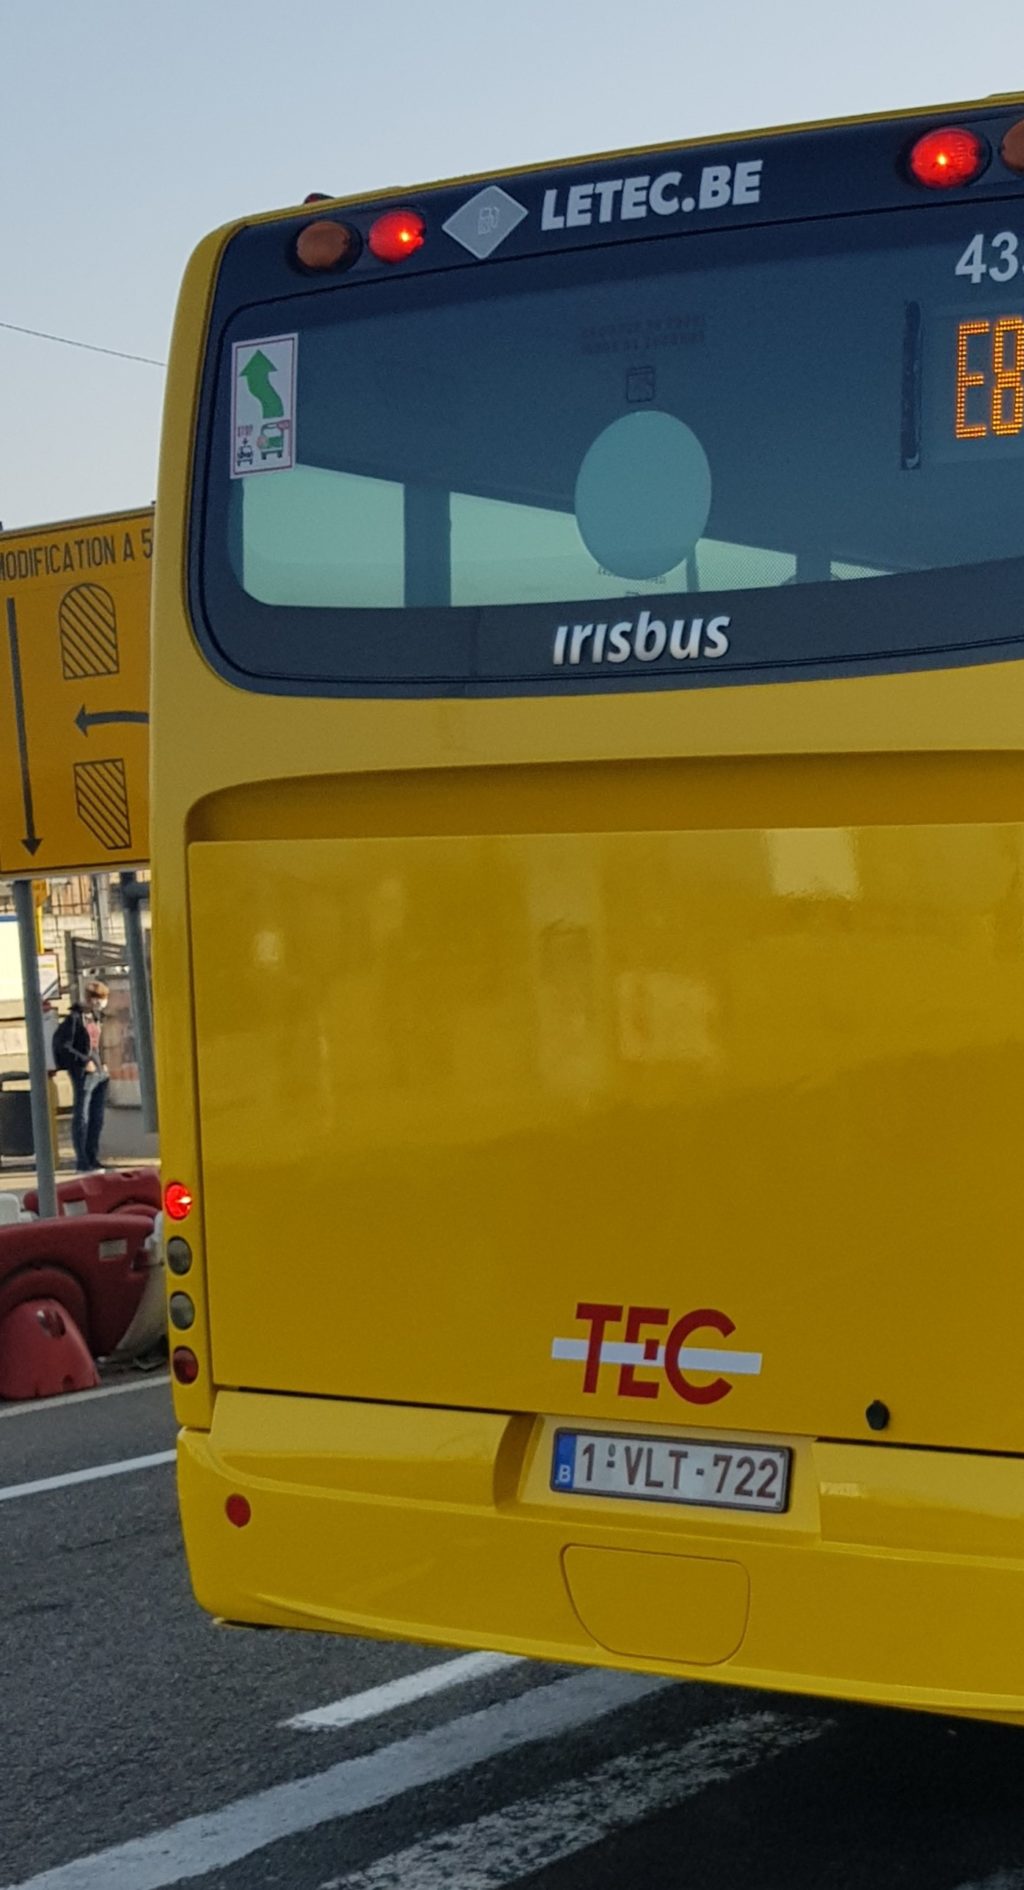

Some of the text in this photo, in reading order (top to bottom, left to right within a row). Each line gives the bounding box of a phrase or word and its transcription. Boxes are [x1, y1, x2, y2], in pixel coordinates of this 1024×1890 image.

[541, 160, 763, 231] LETEC.BE
[123, 532, 135, 561] A
[575, 1302, 736, 1405] TEC
[559, 1464, 571, 1483] B
